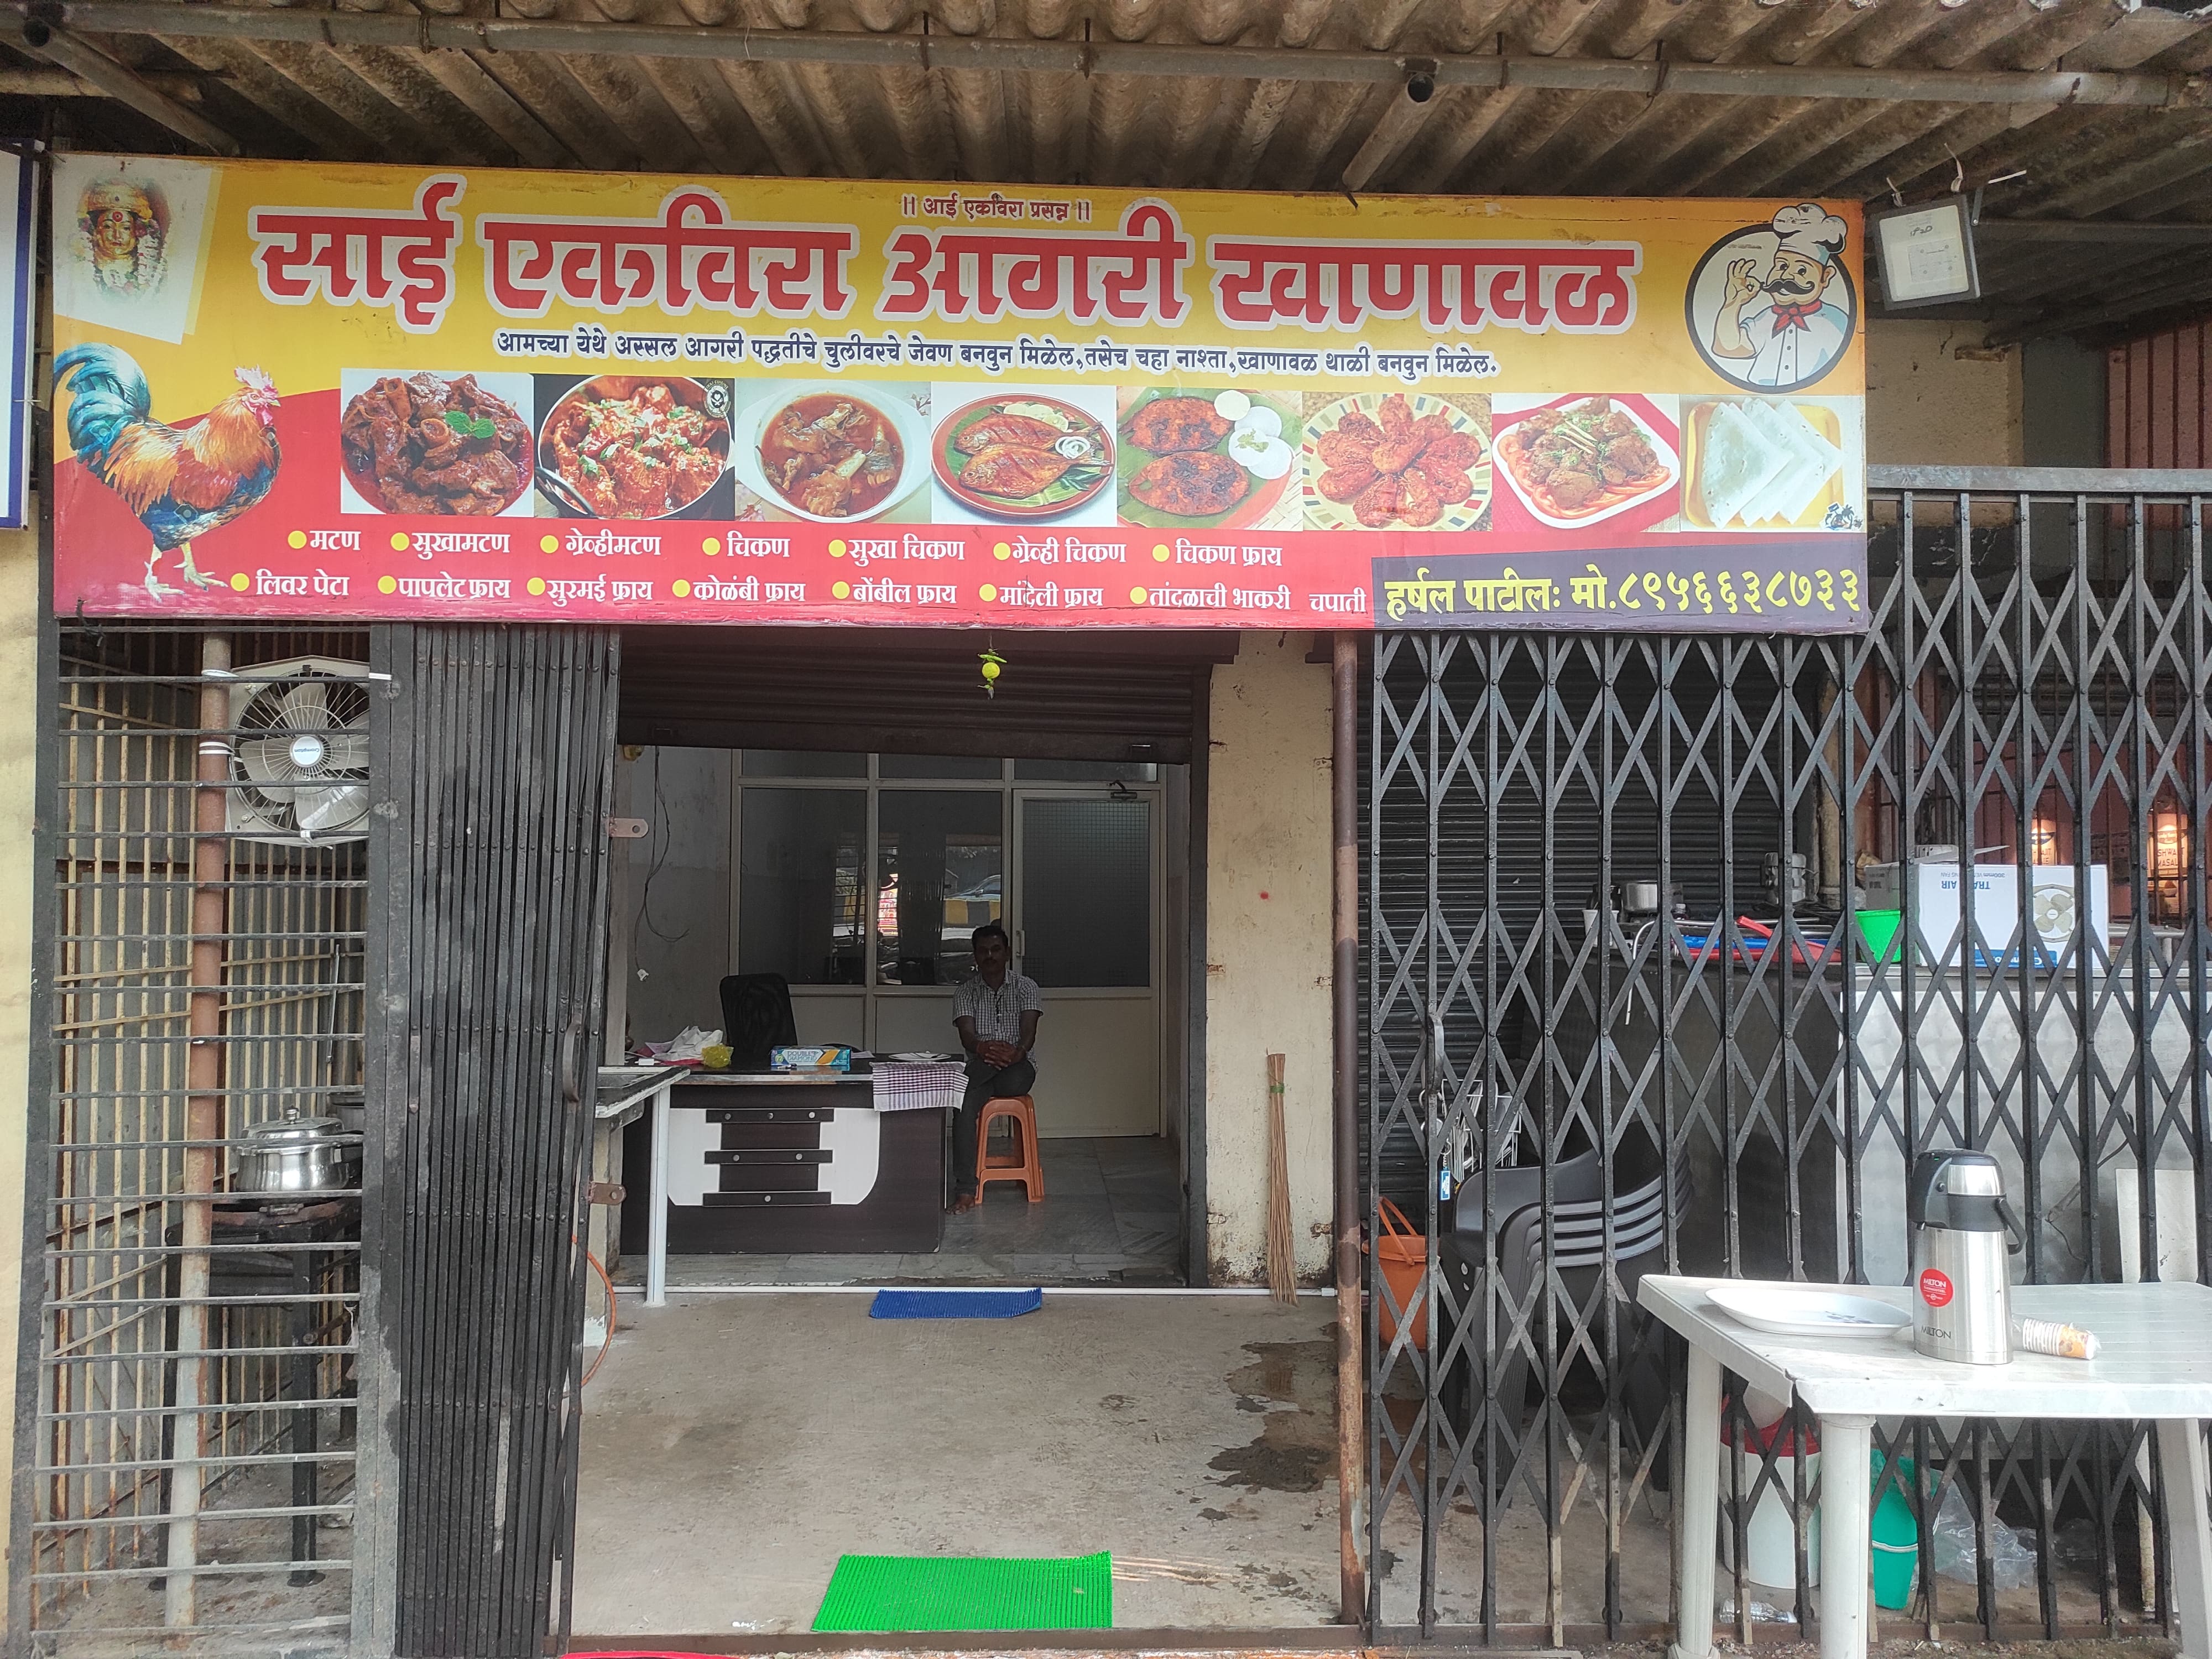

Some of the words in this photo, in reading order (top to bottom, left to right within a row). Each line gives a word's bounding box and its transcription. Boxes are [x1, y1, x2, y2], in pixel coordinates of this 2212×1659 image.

[925, 193, 957, 216] आई
[1031, 202, 1068, 220] प्रसन्न
[258, 183, 457, 324] साई
[485, 194, 850, 310] एकविरा
[884, 206, 1186, 318] आगरी
[1215, 244, 1634, 325] खाणावळ
[498, 333, 568, 352] आमच्या
[576, 327, 607, 353] येथे
[615, 336, 677, 357] अस्सल
[686, 331, 744, 358] आगरी
[824, 334, 901, 367] चुलीवरचे
[908, 336, 953, 362] जेवण
[960, 345, 1013, 371] बनवुन
[1135, 349, 1169, 370] चहा
[1326, 347, 1370, 371] थाळी
[1378, 355, 1429, 380] बनवुन
[310, 531, 361, 550] मटण
[727, 531, 790, 557] चिकण
[848, 540, 898, 566] सुखा
[902, 534, 965, 560] चिकण
[1012, 536, 1060, 564] ग्रेव्ही
[1065, 537, 1126, 562] चिकण
[1175, 538, 1237, 564] चिकण
[1241, 547, 1282, 566] फ्राय
[255, 569, 308, 594] लिवर
[313, 569, 349, 595] पेटा
[398, 571, 467, 598] पापलेट
[468, 580, 511, 599] फ्राय
[547, 574, 606, 607] सुरमई
[612, 582, 653, 601] फ्राय
[693, 575, 759, 601] कोळंबी
[765, 583, 806, 602] फ्राय
[851, 577, 911, 603] बोंबील
[916, 586, 957, 604] फ्राय
[1149, 582, 1227, 607] तांदळाची
[1233, 585, 1291, 609] भाकरी
[1384, 567, 1456, 621] हर्षल
[1063, 588, 1104, 608] फ्राय
[1309, 587, 1366, 612] चपाती
[1941, 880, 1957, 889] AIR
[1923, 1278, 1946, 1288] MILTON
[1921, 1325, 1952, 1339] MILTON
